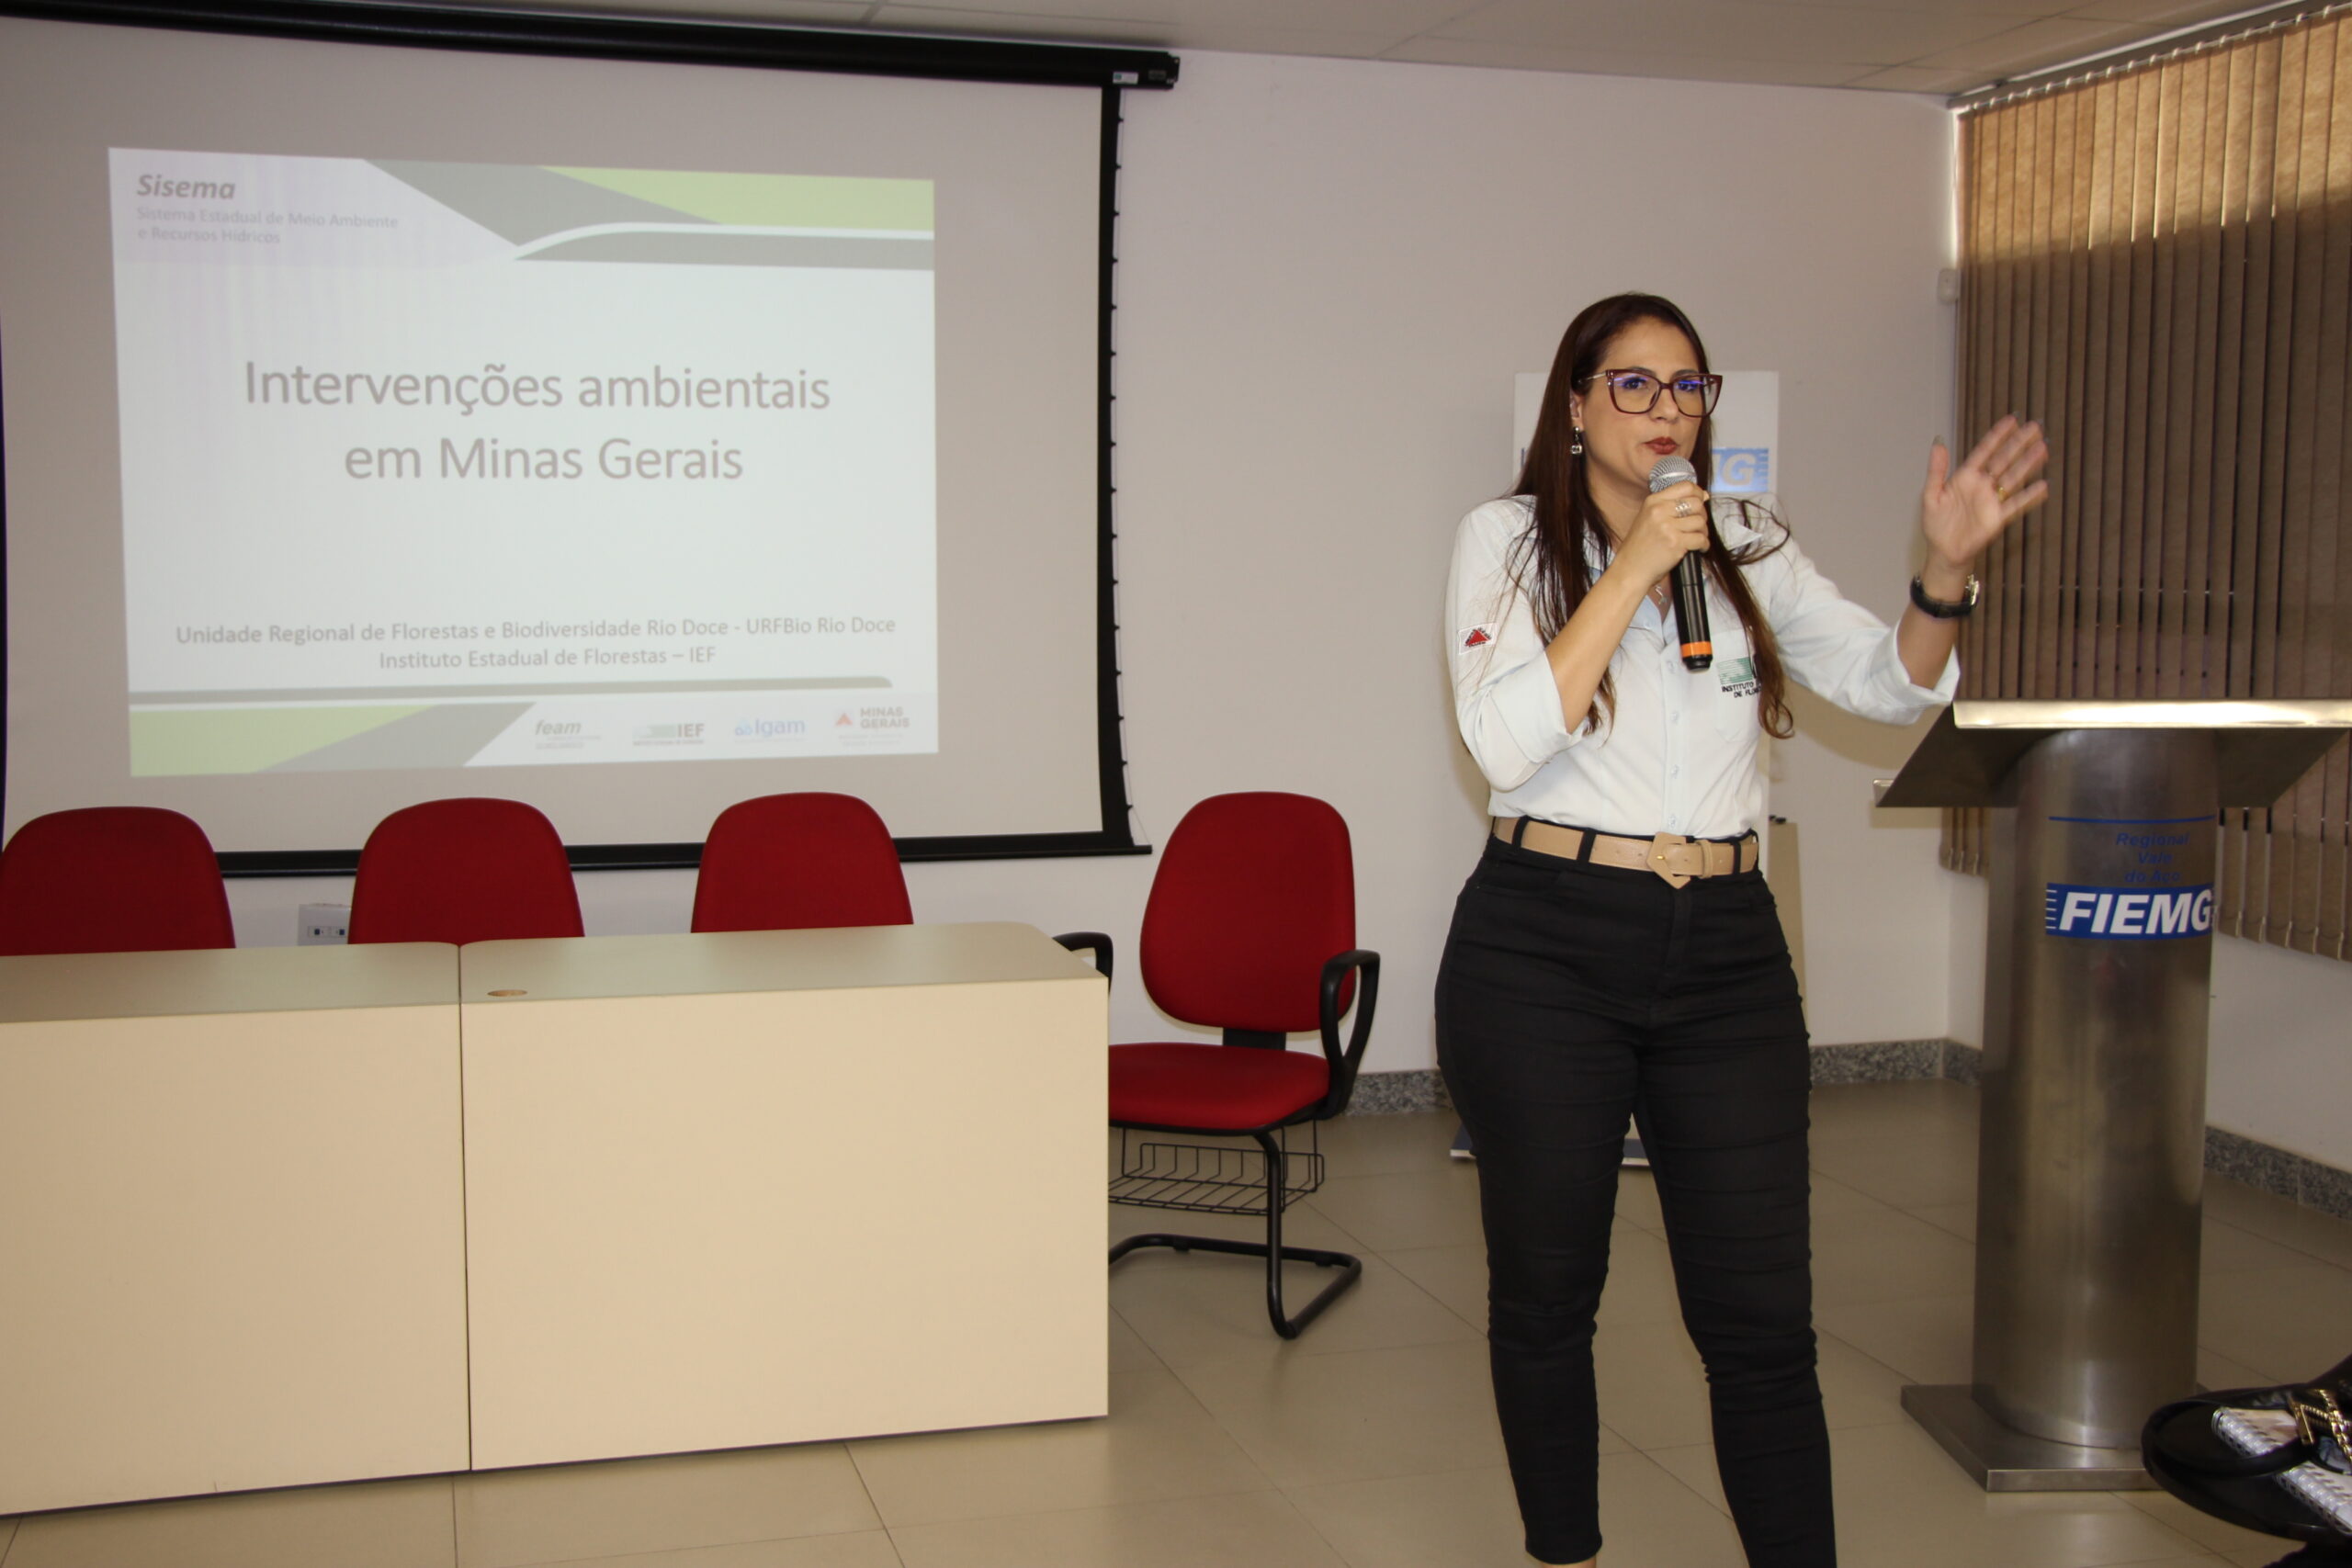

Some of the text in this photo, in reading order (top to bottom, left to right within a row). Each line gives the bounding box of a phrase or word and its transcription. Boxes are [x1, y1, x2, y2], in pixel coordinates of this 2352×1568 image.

[136, 174, 235, 199] Sisema
[136, 208, 399, 228] Sistema Estadual de Meio Ambiente
[138, 230, 148, 241] e
[152, 227, 218, 242] Recursos
[245, 361, 831, 416] Intervenções ambientais
[345, 437, 743, 480] em Minas Gerais
[176, 625, 262, 644] Unidade
[269, 624, 355, 646] Regional
[361, 624, 385, 641] de
[391, 622, 479, 640] Florestas
[485, 626, 496, 639] e
[503, 619, 641, 639] Biodiversidade
[648, 619, 676, 637] Rio
[683, 619, 729, 636] Doce
[747, 617, 812, 635] URFBio
[818, 617, 846, 634] Rio
[852, 616, 896, 633] Doce
[380, 650, 461, 669] Instituto
[469, 649, 548, 667] Estadual
[555, 649, 578, 666] de
[583, 647, 667, 665] Florestas
[690, 646, 716, 663] IEF
[1721, 681, 1754, 693] INSTITUTO
[860, 706, 904, 718] MINAS
[535, 720, 582, 736] feam
[676, 723, 705, 738] IEF
[860, 717, 910, 729] GERAIS
[2116, 831, 2190, 849] Regional
[2138, 852, 2174, 864] Vale
[2123, 868, 2147, 883] do
[2058, 888, 2213, 935] FIEMG
